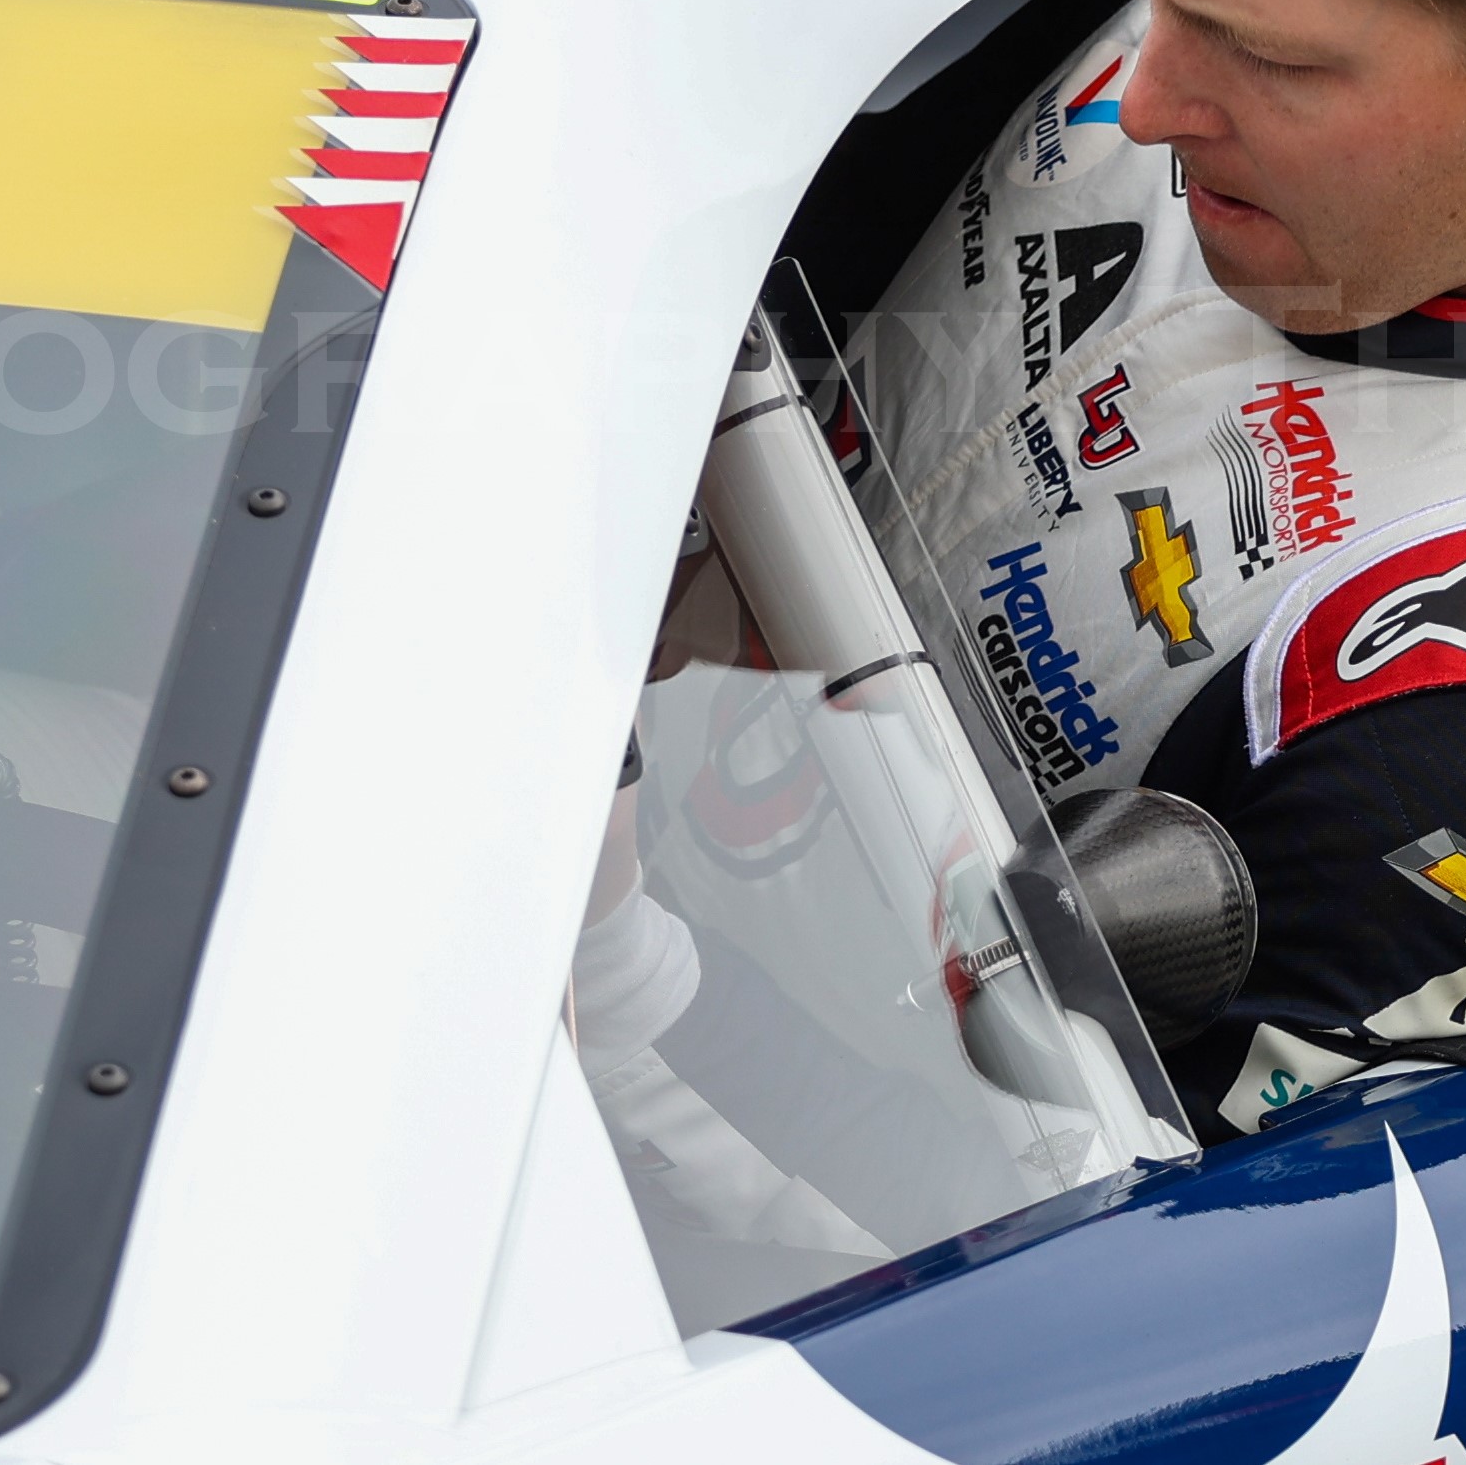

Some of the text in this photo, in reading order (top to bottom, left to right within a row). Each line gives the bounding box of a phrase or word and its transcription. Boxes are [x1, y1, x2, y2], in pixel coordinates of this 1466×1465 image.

[1015, 233, 1052, 393] AXALTA
[1016, 401, 1084, 520] LIBERTY
[1240, 380, 1357, 554] Hendrick
[1243, 421, 1300, 563] MOTORSPORTS
[977, 613, 1086, 789] cars.com
[979, 541, 1120, 767] Hendrick
